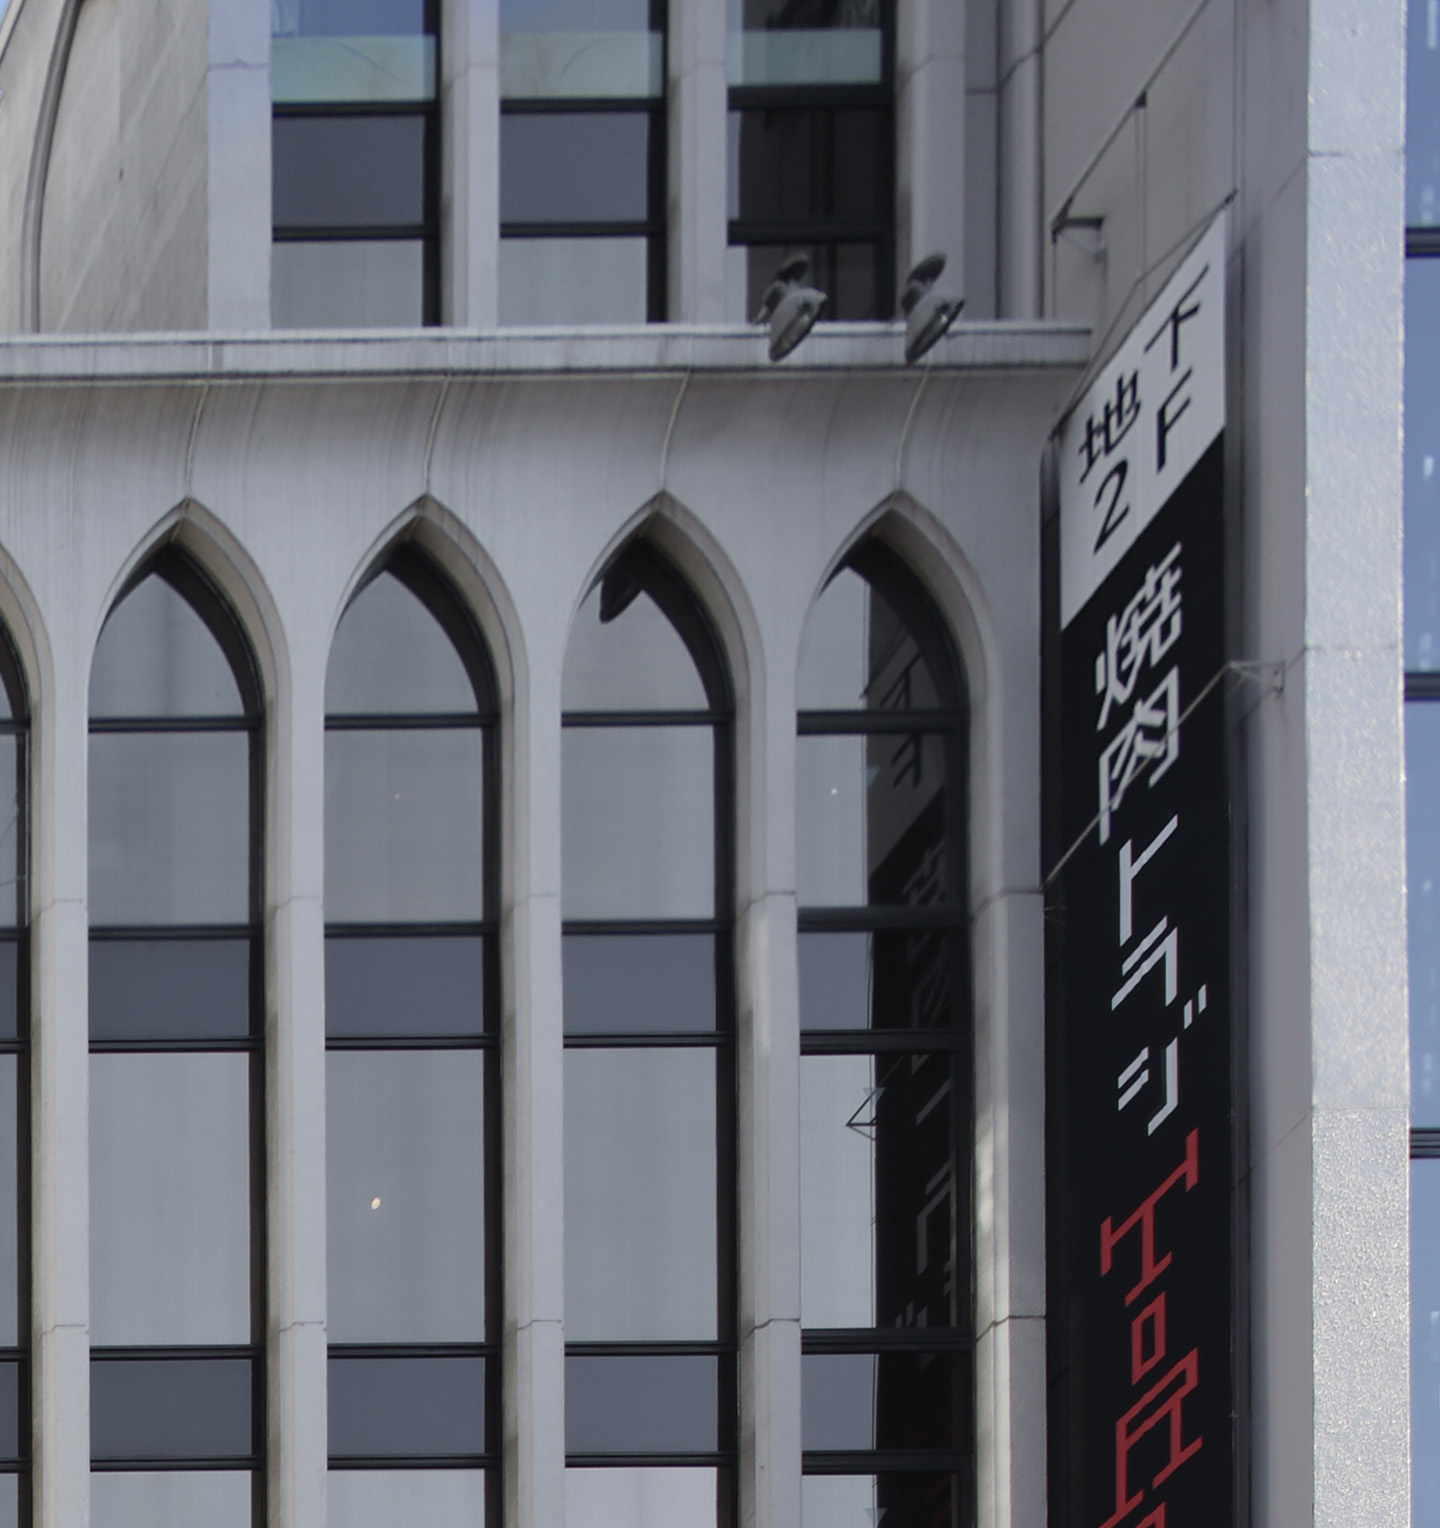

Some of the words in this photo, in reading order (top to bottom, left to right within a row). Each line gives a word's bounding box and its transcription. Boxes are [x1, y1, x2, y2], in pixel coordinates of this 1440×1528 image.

[1096, 542, 1207, 1136] 焼肉トラジ
